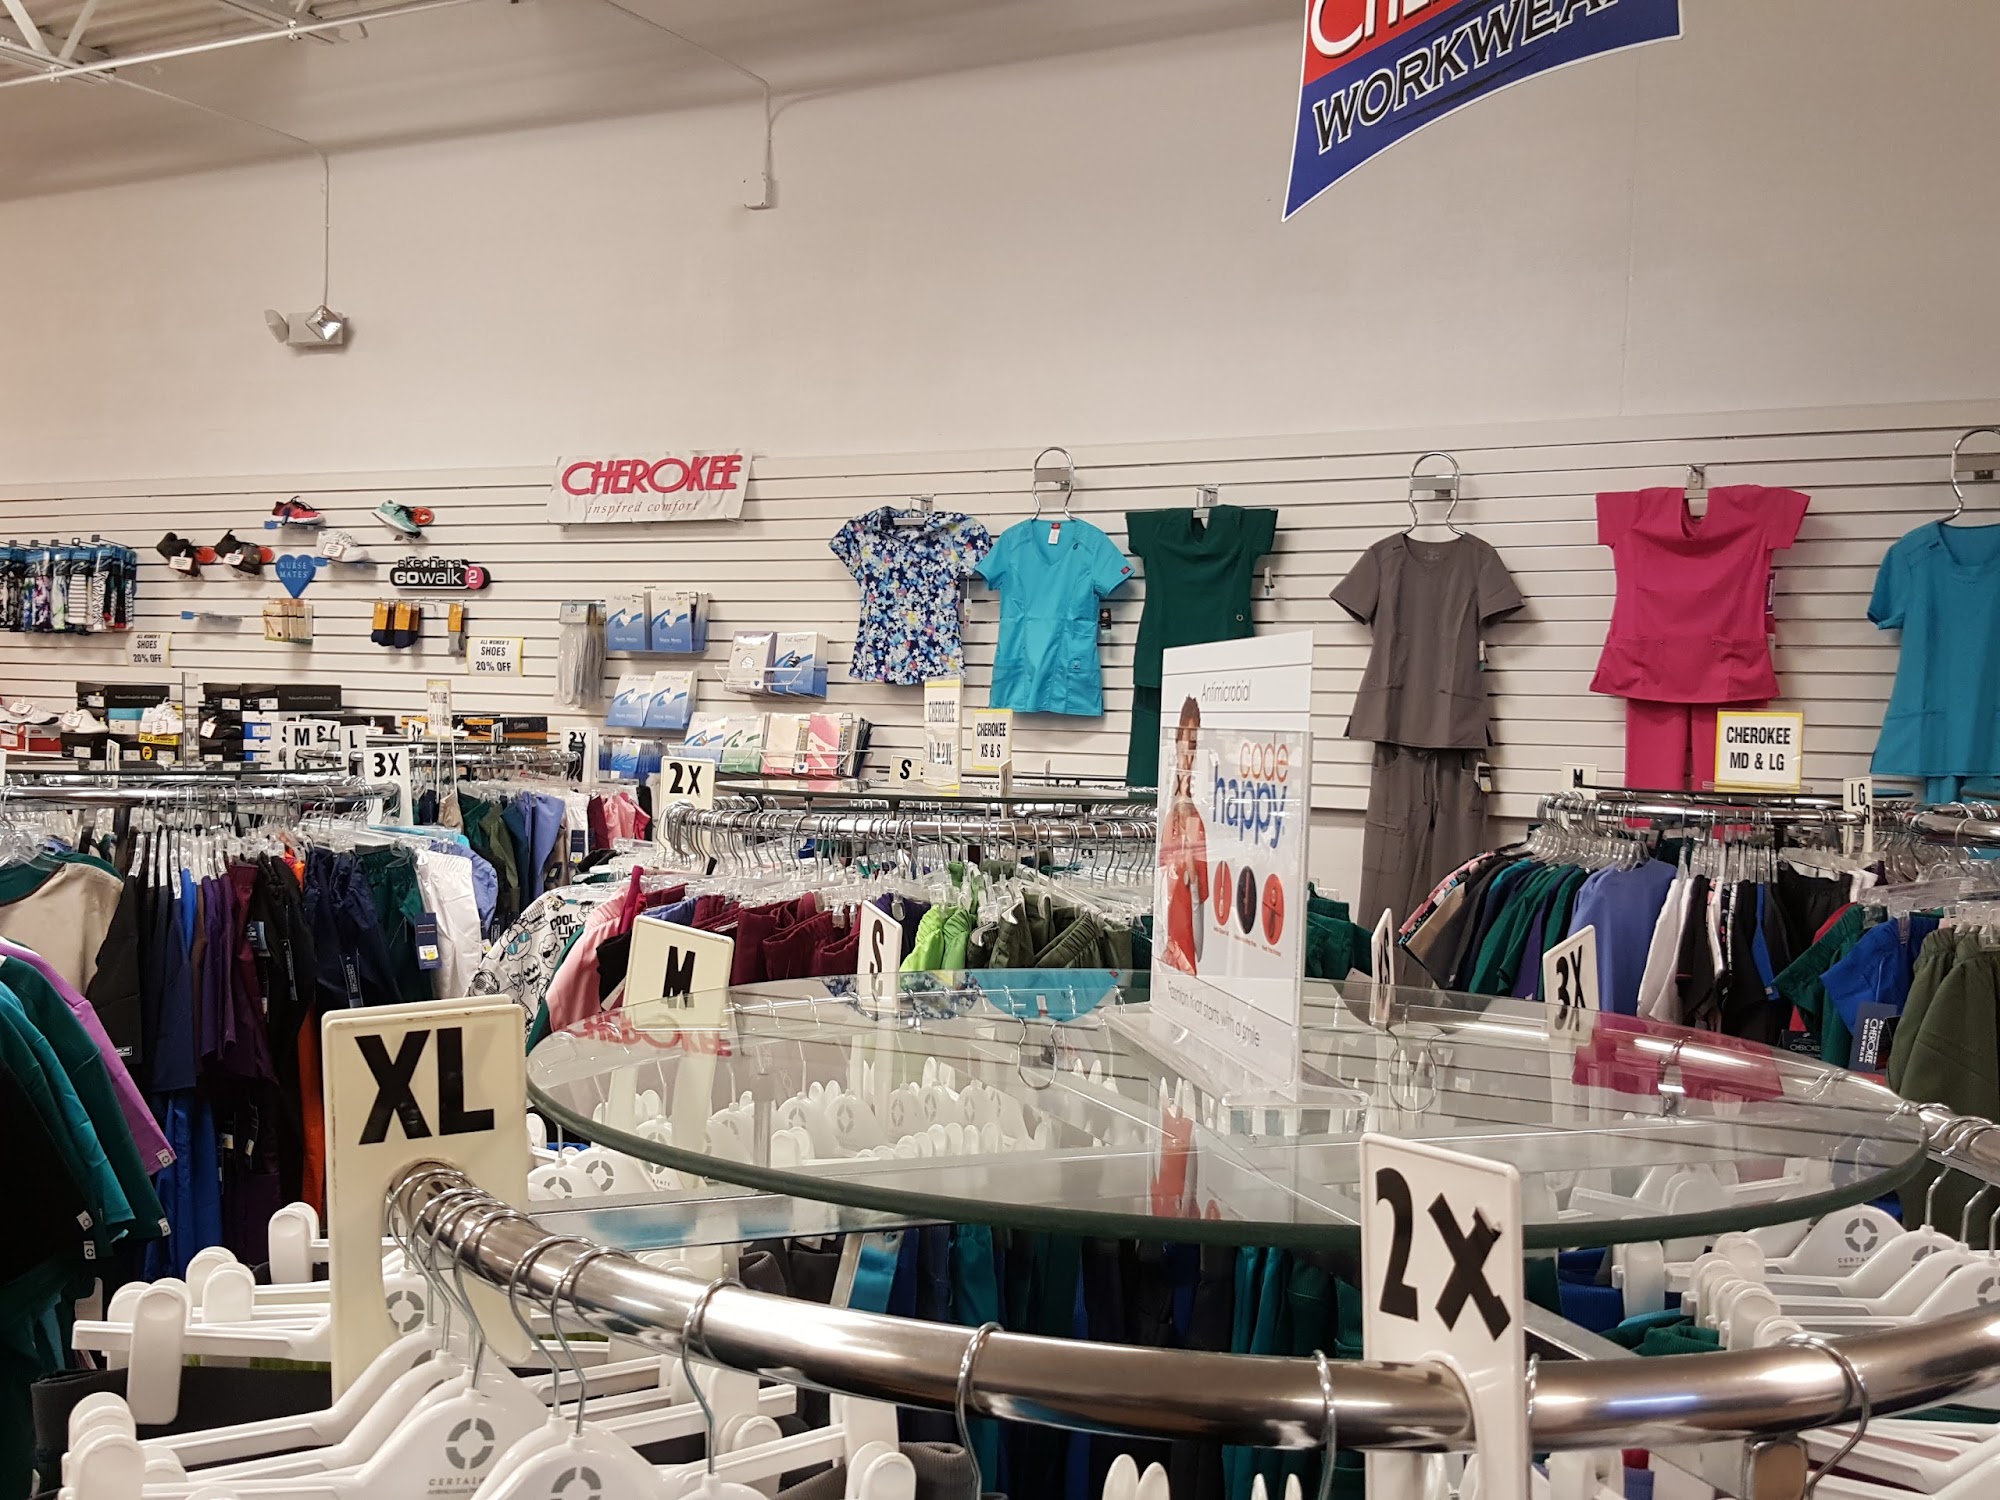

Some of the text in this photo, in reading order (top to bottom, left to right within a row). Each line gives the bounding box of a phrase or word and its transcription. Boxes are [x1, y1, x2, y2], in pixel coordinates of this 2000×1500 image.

[561, 455, 743, 496] CHEROKEE
[588, 499, 699, 517] inspired comfort
[279, 561, 307, 570] NURSE
[279, 570, 308, 578] MATES
[468, 570, 478, 584] 2
[137, 640, 157, 649] SHOES
[481, 646, 506, 657] SHOES
[133, 653, 162, 663] 20% OFF
[475, 661, 512, 672] 20% OFF
[1201, 679, 1252, 702] Antimicrobial
[928, 700, 955, 722] CHEROKEE
[294, 728, 310, 746] M
[976, 722, 1007, 737] CHEROKEE
[1726, 726, 1791, 745] CHEROKEE
[980, 743, 1001, 758] XS & S
[1239, 733, 1289, 782] code
[373, 752, 401, 777] 3X
[900, 759, 912, 779] S
[1729, 752, 1785, 771] MD & LG
[669, 762, 703, 797] 2X
[1573, 768, 1583, 788] M
[1851, 783, 1865, 806] LG
[1212, 761, 1287, 849] happy
[549, 914, 577, 931] COOL
[869, 919, 884, 996] S
[661, 945, 696, 1009] M
[1553, 945, 1586, 1031] 3X
[1864, 1018, 1879, 1065] CHEROKEE
[354, 1026, 495, 1146] XL
[1375, 1167, 1512, 1341] 2X
